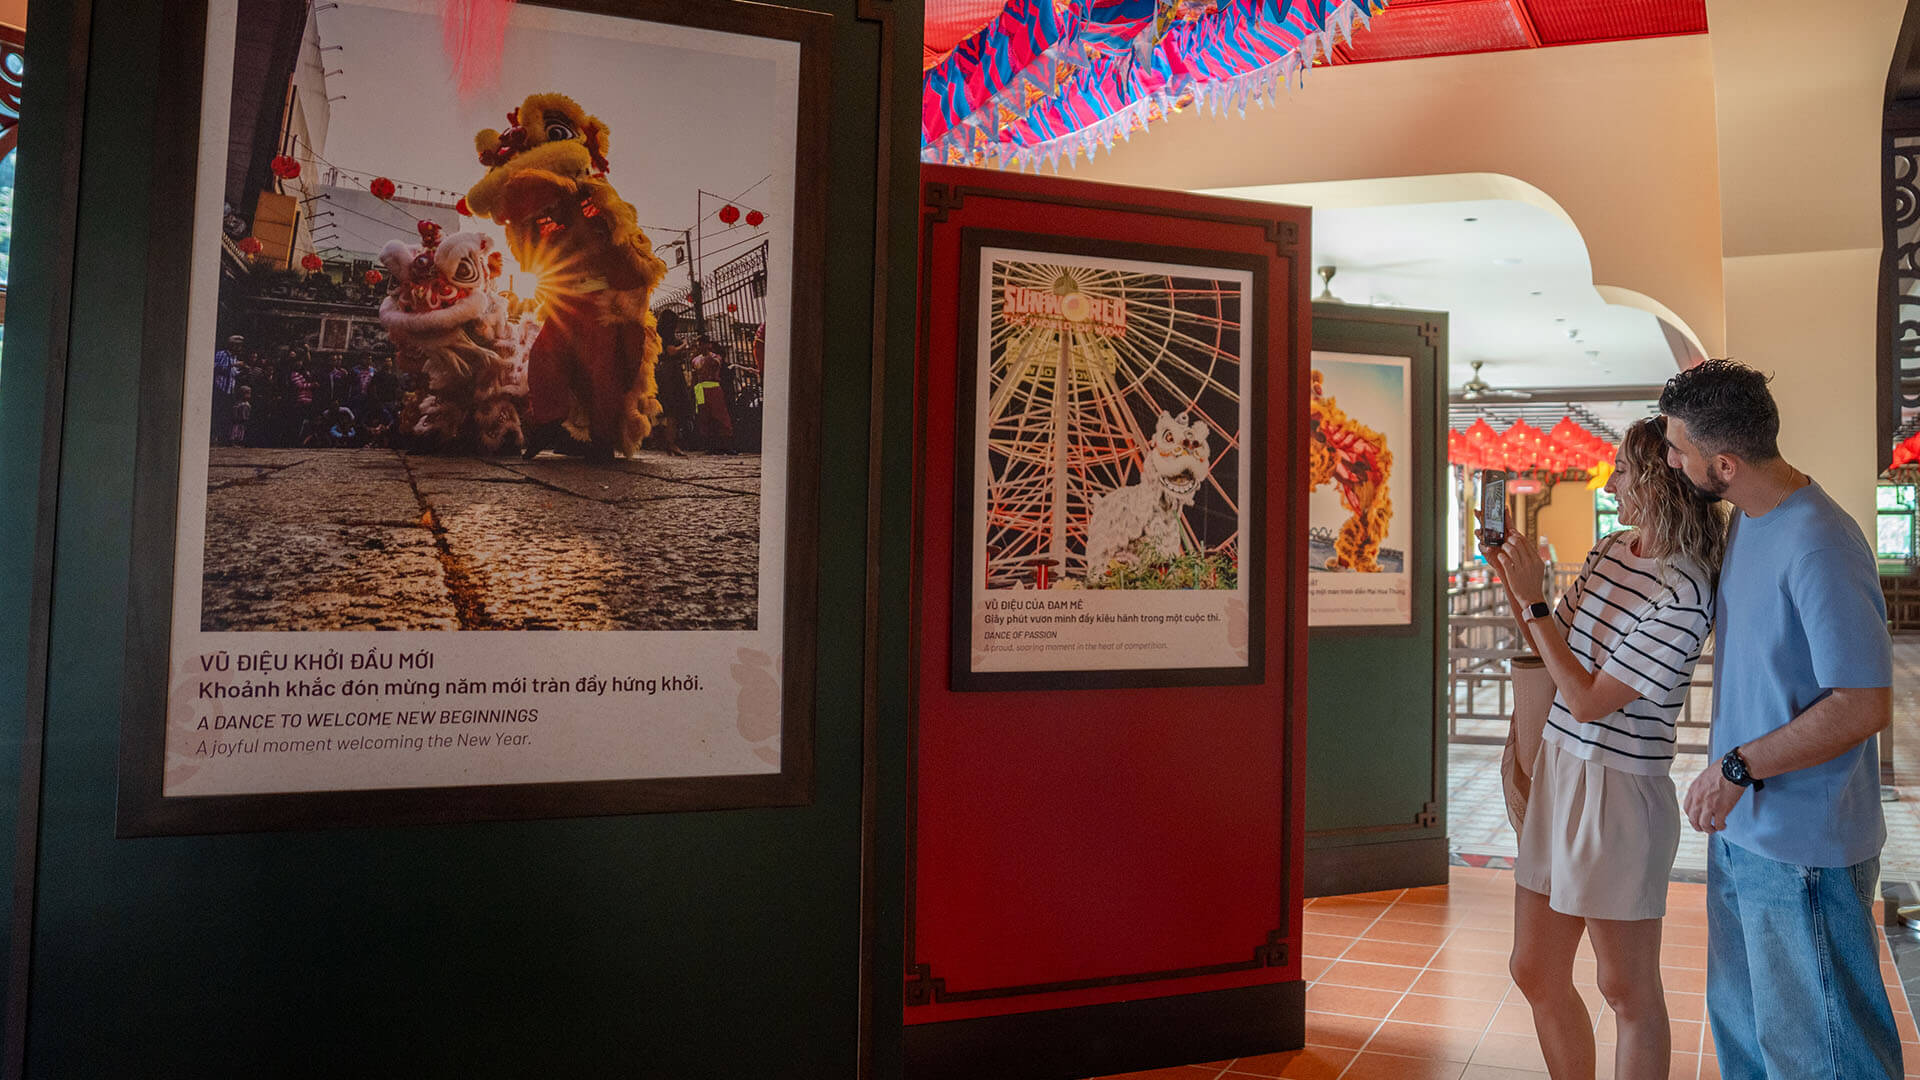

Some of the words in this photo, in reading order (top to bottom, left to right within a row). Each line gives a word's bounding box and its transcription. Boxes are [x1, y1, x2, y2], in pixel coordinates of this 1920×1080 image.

[1003, 314, 1026, 326] THE
[1031, 318, 1072, 331] WORLD
[1077, 322, 1091, 333] OF
[985, 598, 998, 610] VŨ
[1001, 598, 1023, 612] ĐIỆU
[1025, 598, 1045, 610] CỦA
[1047, 600, 1068, 610] ĐAM
[1070, 598, 1084, 610] MÊ
[1006, 614, 1028, 625] phút
[1030, 615, 1053, 624] vươn
[1141, 614, 1164, 624] trong
[1166, 613, 1183, 623] một
[1184, 613, 1205, 623] cuộc
[984, 631, 1011, 640] DANCE
[1012, 631, 1024, 640] OF
[1024, 630, 1058, 640] PASSION
[1045, 643, 1075, 651] moment
[1077, 642, 1084, 650] in
[1085, 642, 1097, 650] the
[1098, 642, 1114, 650] heat
[1115, 642, 1123, 650] of
[200, 651, 229, 671] VŨ
[237, 650, 288, 675] ĐIỆU
[294, 648, 344, 671] KHỞI
[350, 646, 393, 670] ĐẦU
[399, 649, 434, 669] MỚI
[199, 680, 280, 699] Khoảnh
[286, 677, 336, 697] khắc
[342, 679, 379, 696] đón
[384, 680, 440, 699] mừng
[445, 678, 487, 695] năm
[492, 677, 527, 693] mới
[532, 678, 570, 693] tràn
[575, 674, 607, 695] đầy
[612, 676, 657, 695] hứng
[661, 674, 704, 692] khởi.
[197, 716, 209, 730] A
[214, 714, 276, 730] DANCE
[281, 713, 302, 729] TO
[307, 711, 393, 728] WELCOME
[397, 710, 436, 725] NEW
[439, 708, 538, 724] BEGINNINGS
[196, 741, 207, 756] A
[209, 738, 258, 758] joyful
[263, 738, 332, 753] moment
[337, 734, 424, 751] welcoming
[428, 734, 452, 748] the
[457, 733, 491, 747] New
[495, 731, 532, 746] Year.
